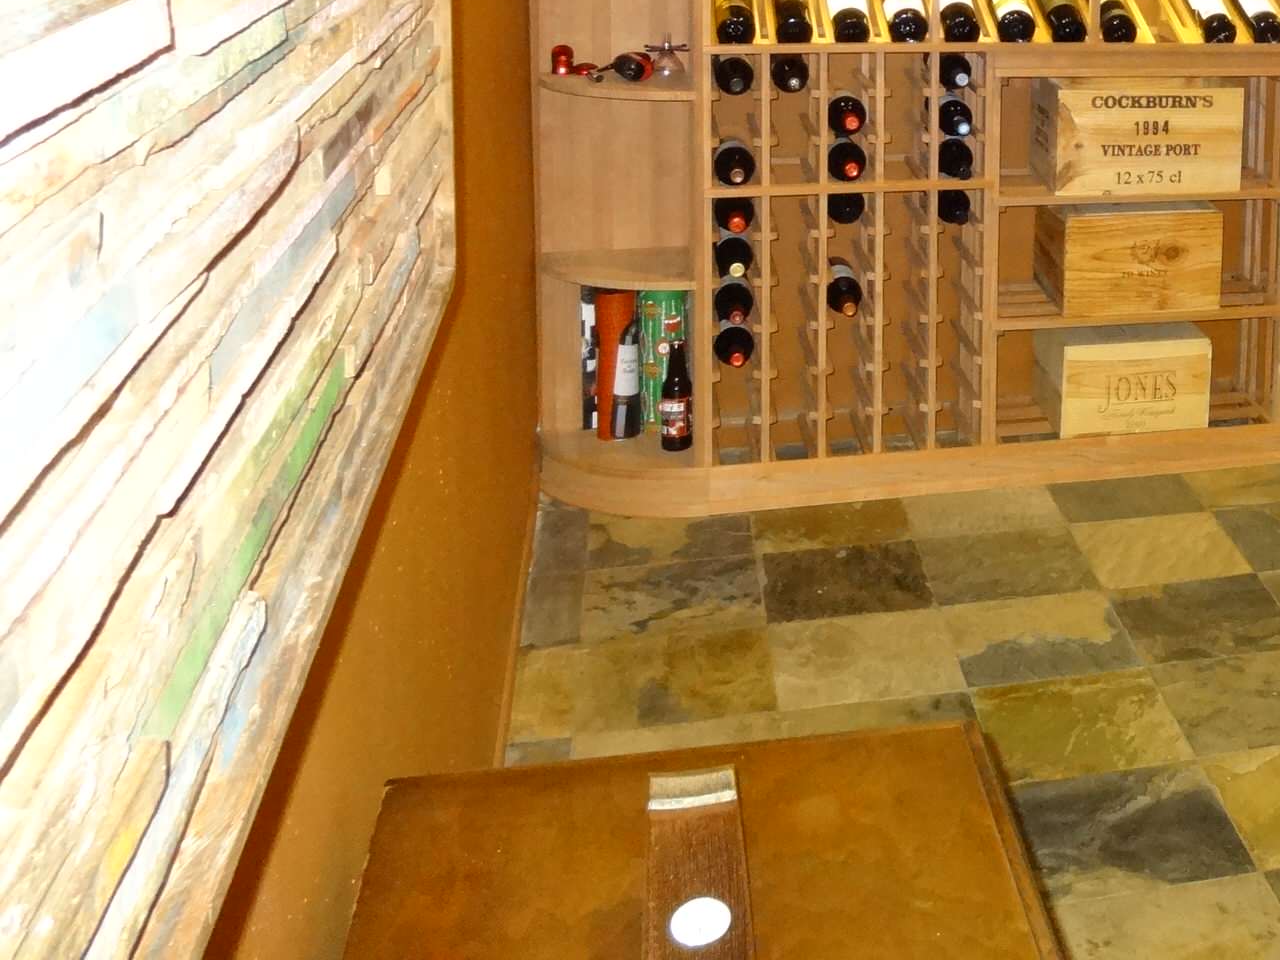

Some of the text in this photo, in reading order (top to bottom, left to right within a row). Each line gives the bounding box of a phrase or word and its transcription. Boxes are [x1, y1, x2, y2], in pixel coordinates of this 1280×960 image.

[1091, 95, 1214, 109] COCKBURN'S
[1134, 120, 1170, 136] 1994
[1101, 143, 1201, 157] VINTAGE PORT
[1116, 170, 1182, 185] 12 x 75 cl
[1097, 373, 1177, 414] JONES
